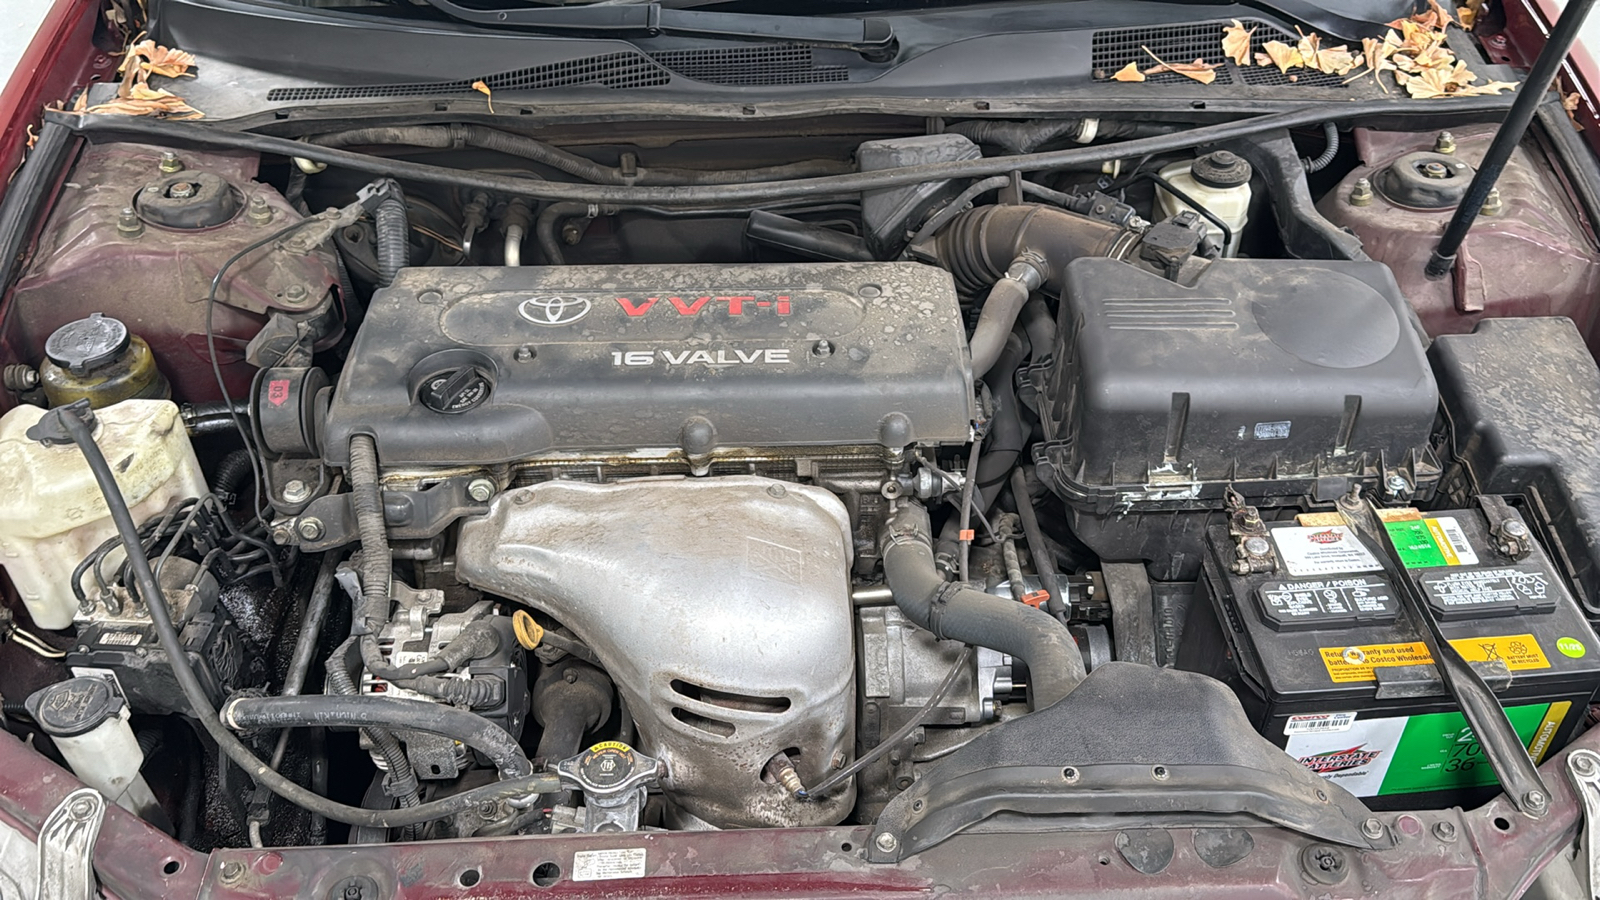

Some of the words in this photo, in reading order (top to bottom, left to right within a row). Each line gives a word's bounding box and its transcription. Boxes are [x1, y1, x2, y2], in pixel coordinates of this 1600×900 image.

[616, 296, 790, 316] VVT-i
[611, 351, 654, 366] 16
[662, 350, 790, 364] VALVE
[1431, 525, 1453, 558] AUTOMOTIVE
[1287, 581, 1324, 590] DANGER
[1332, 579, 1367, 587] POISON
[599, 742, 627, 750] CAUTION
[1300, 751, 1377, 763] INTERSTATE
[1306, 758, 1369, 769] ATTERIES
[1445, 757, 1475, 772] 36
